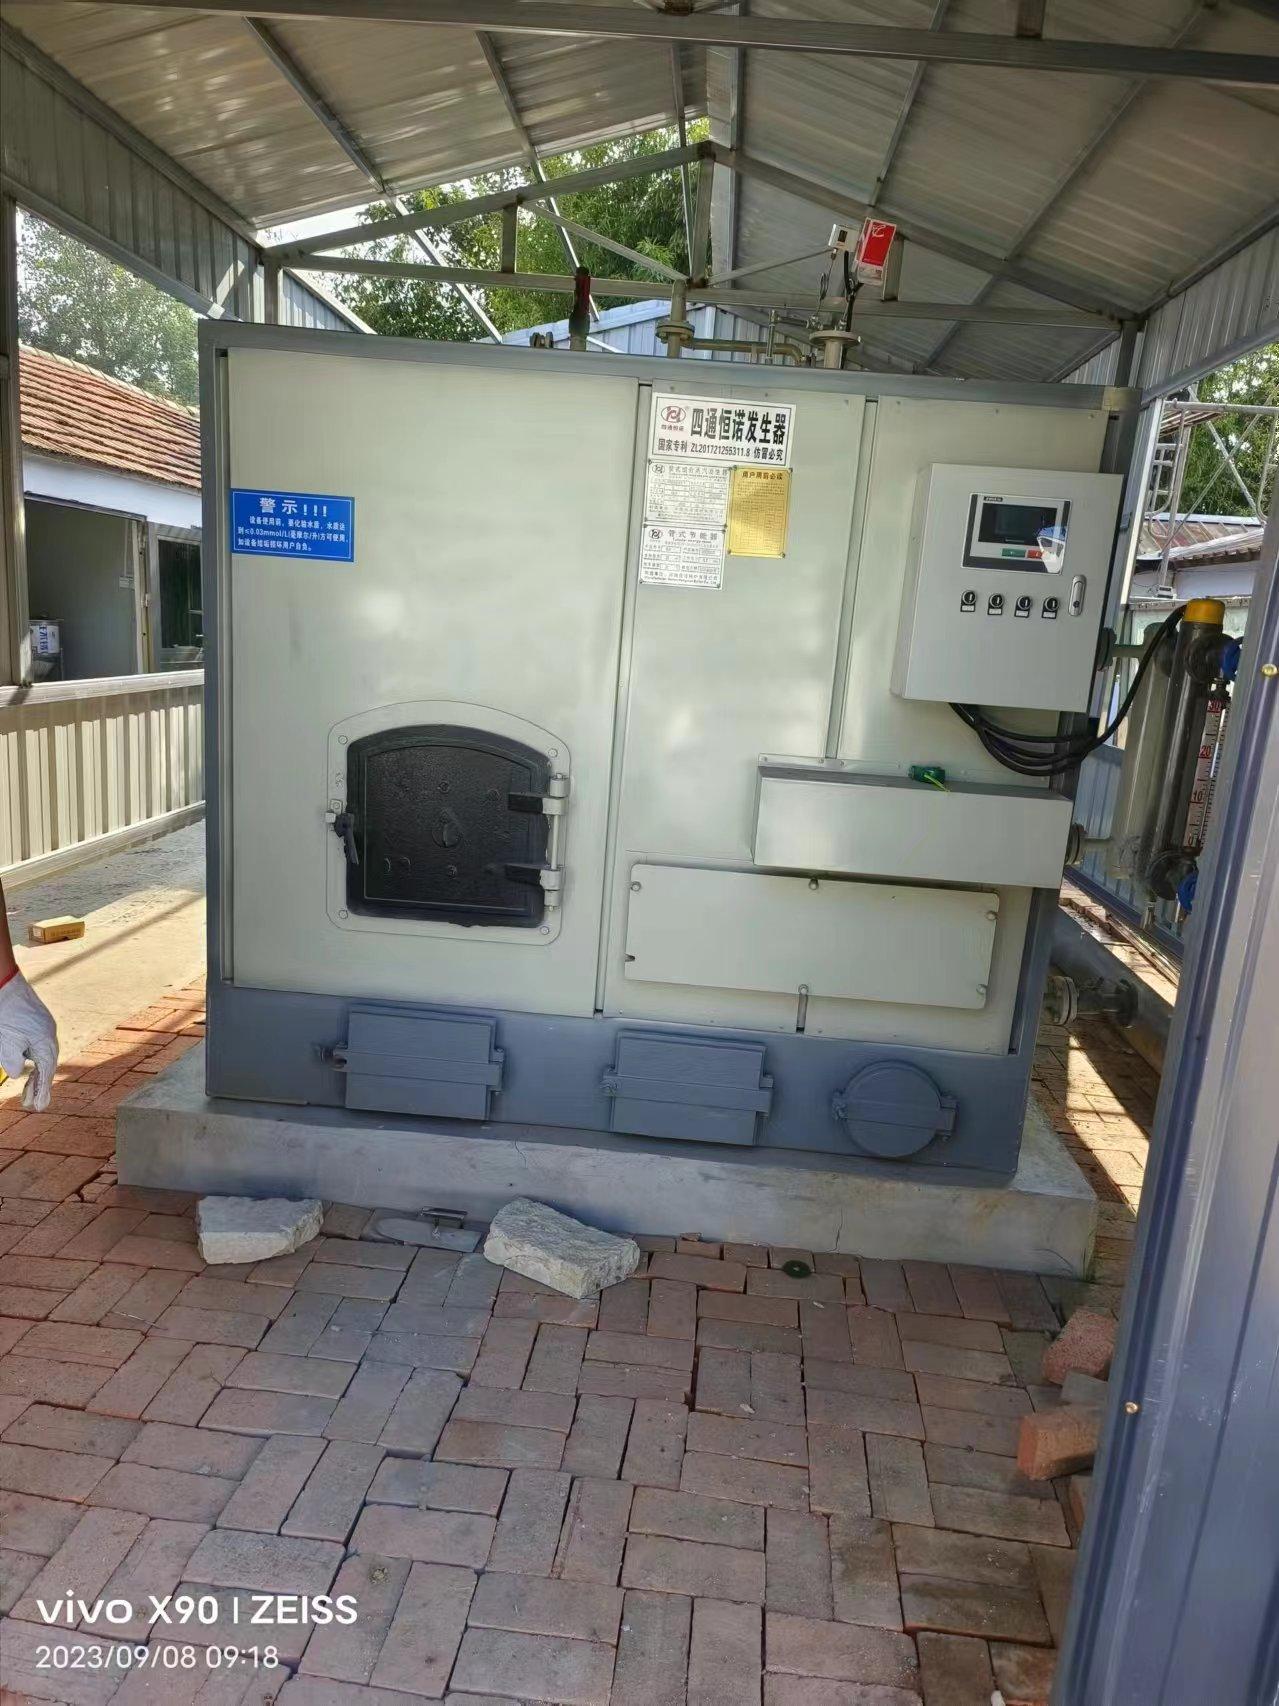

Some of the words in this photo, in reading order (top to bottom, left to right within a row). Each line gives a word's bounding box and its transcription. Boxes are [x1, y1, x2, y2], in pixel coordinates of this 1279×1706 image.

[691, 407, 787, 446] 四通恒诺发生器
[658, 438, 688, 453] 国家专利
[1200, 745, 1211, 757] 20
[1192, 791, 1202, 801] 10
